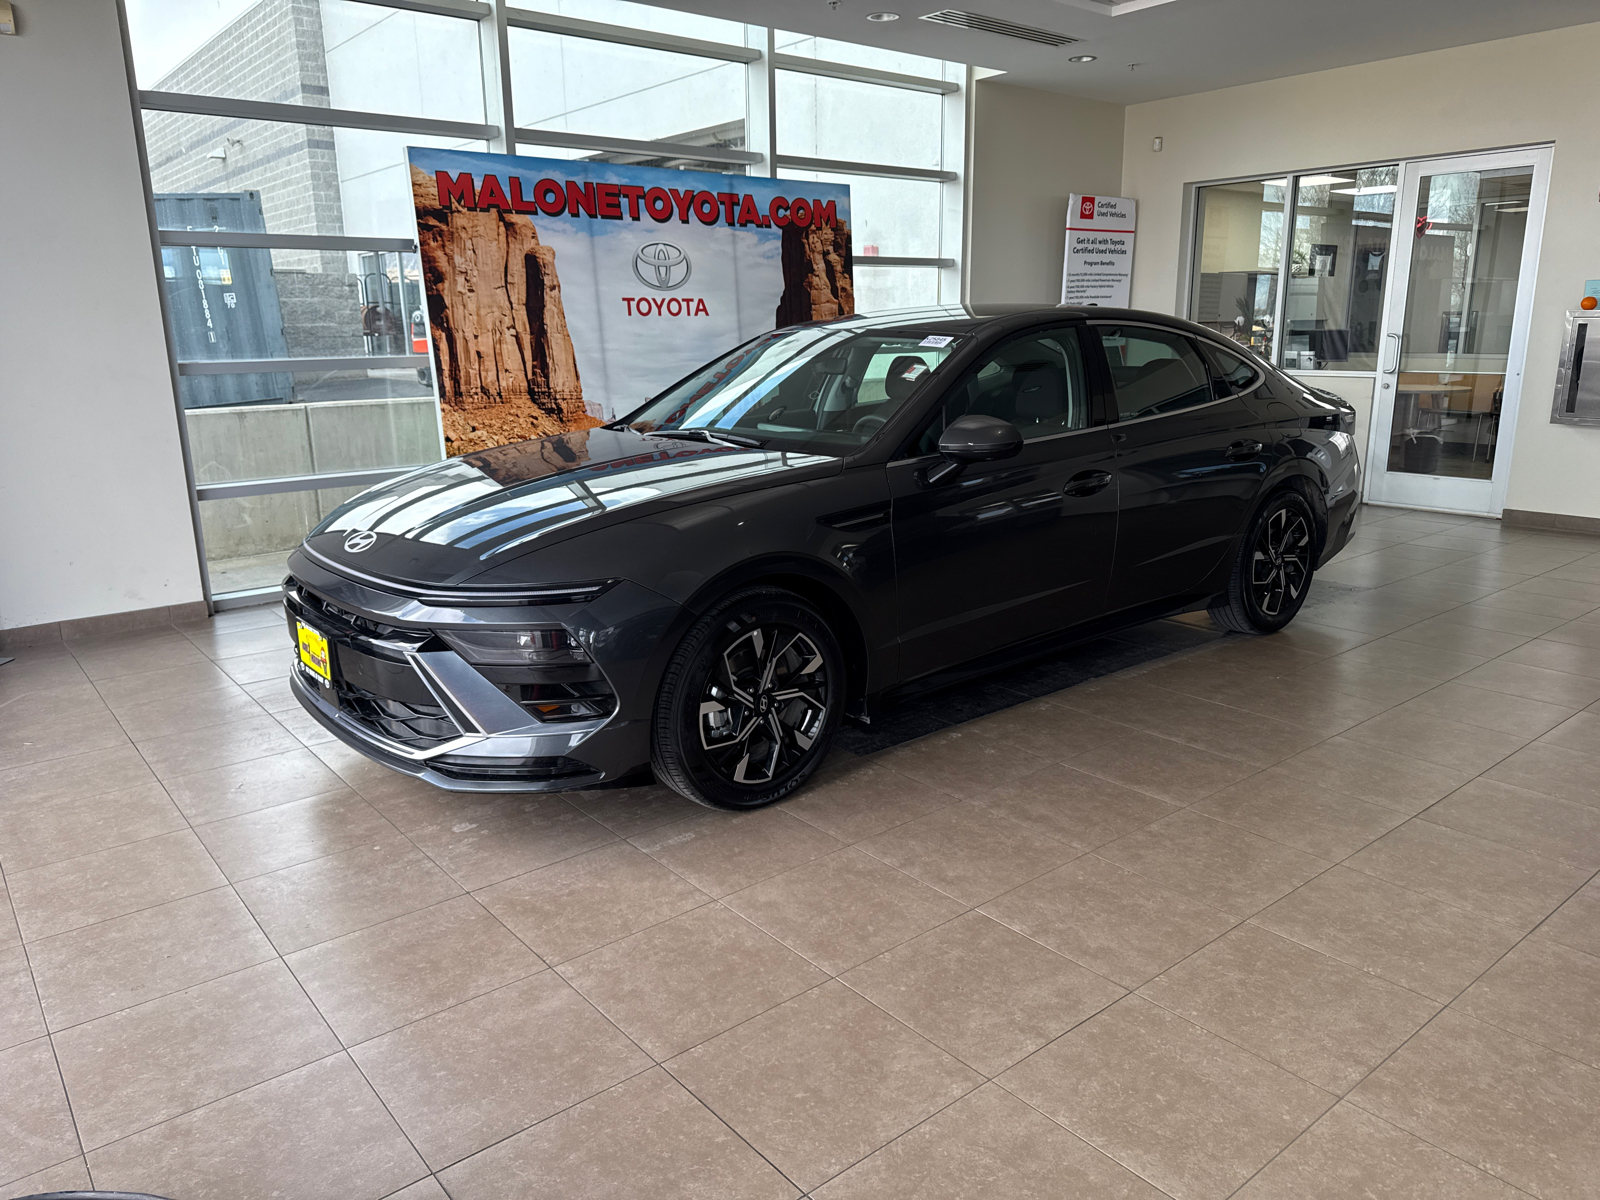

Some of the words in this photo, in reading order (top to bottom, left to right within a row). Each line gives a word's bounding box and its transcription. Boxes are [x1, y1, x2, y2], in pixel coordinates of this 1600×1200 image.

[435, 170, 838, 231] MALONETOYOTA.COM
[1109, 239, 1125, 247] Toyota
[622, 297, 709, 316] TOYOTA
